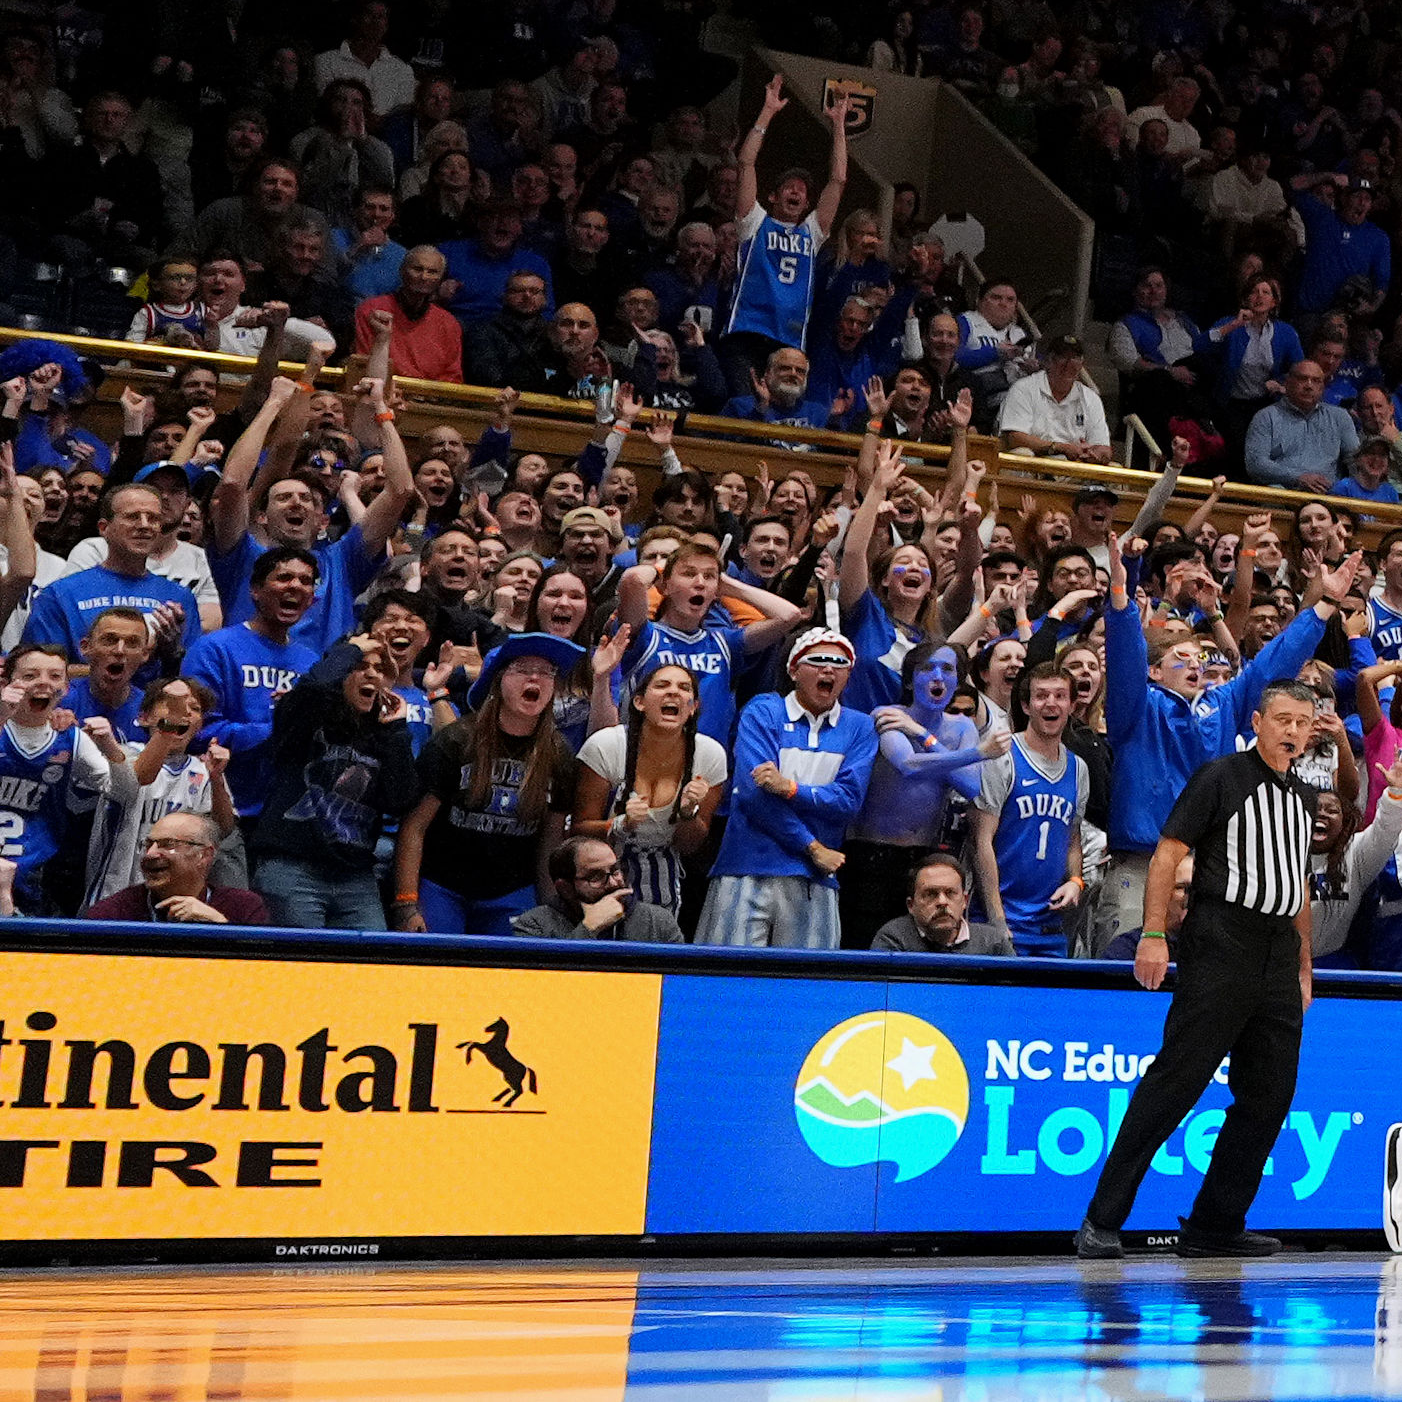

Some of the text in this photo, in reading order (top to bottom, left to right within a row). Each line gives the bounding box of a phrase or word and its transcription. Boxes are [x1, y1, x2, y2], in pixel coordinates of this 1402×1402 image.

[767, 232, 811, 257] DUKE
[779, 258, 797, 284] 5
[241, 664, 300, 692] DUK
[654, 651, 717, 675] DUKE
[1016, 794, 1073, 826] DUKE
[1036, 821, 1050, 860] 1
[0, 1012, 439, 1114] inental
[985, 1039, 1053, 1081] NC
[0, 1140, 324, 1188] TIRE
[276, 1244, 379, 1257] DAKTRONICS
